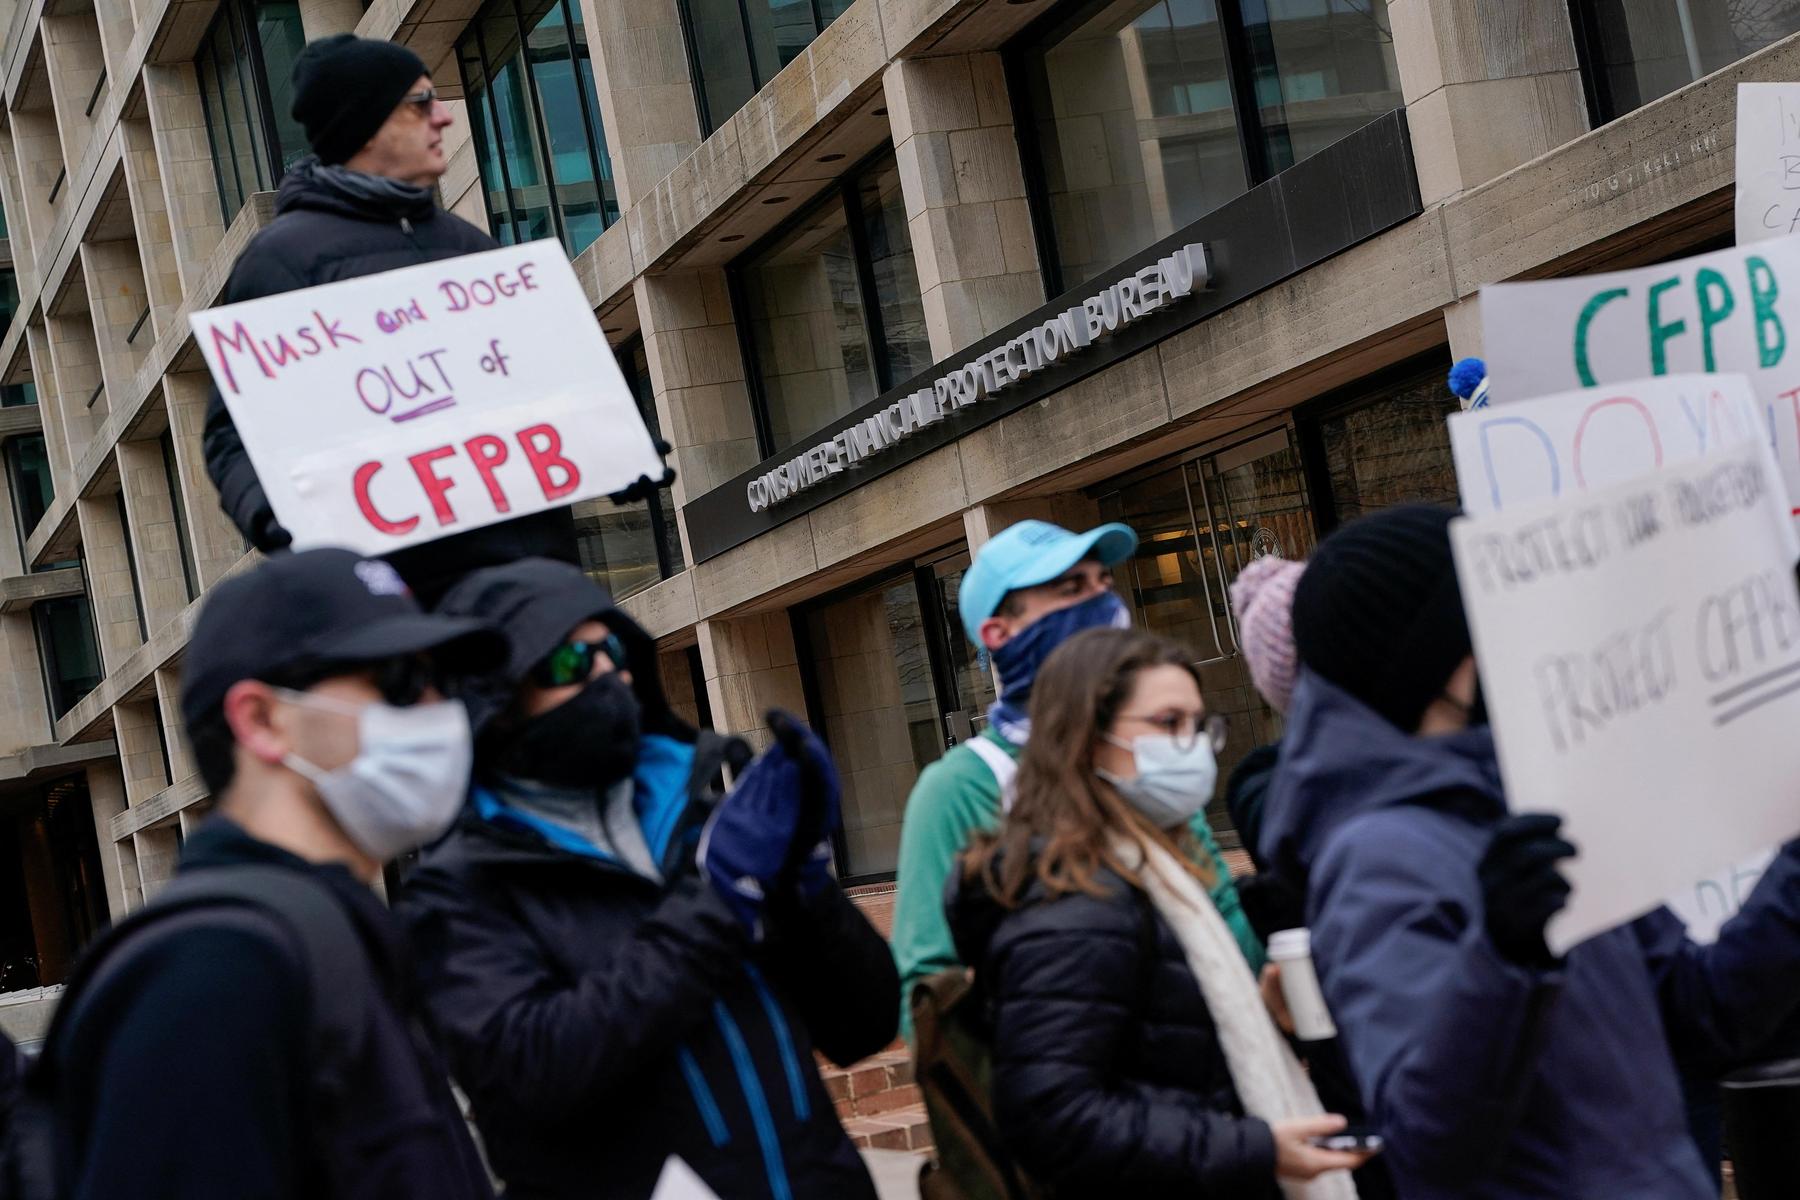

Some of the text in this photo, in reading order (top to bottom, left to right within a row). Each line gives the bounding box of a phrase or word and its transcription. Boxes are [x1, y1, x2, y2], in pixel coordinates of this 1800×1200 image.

[210, 263, 538, 394] Musk and DOGE
[356, 339, 510, 414] OUT of
[747, 243, 1207, 513] CONSUMER FINANCIAL PROTECTION BUREAU
[1574, 256, 1786, 387] CFPB
[353, 423, 580, 536] CFPB
